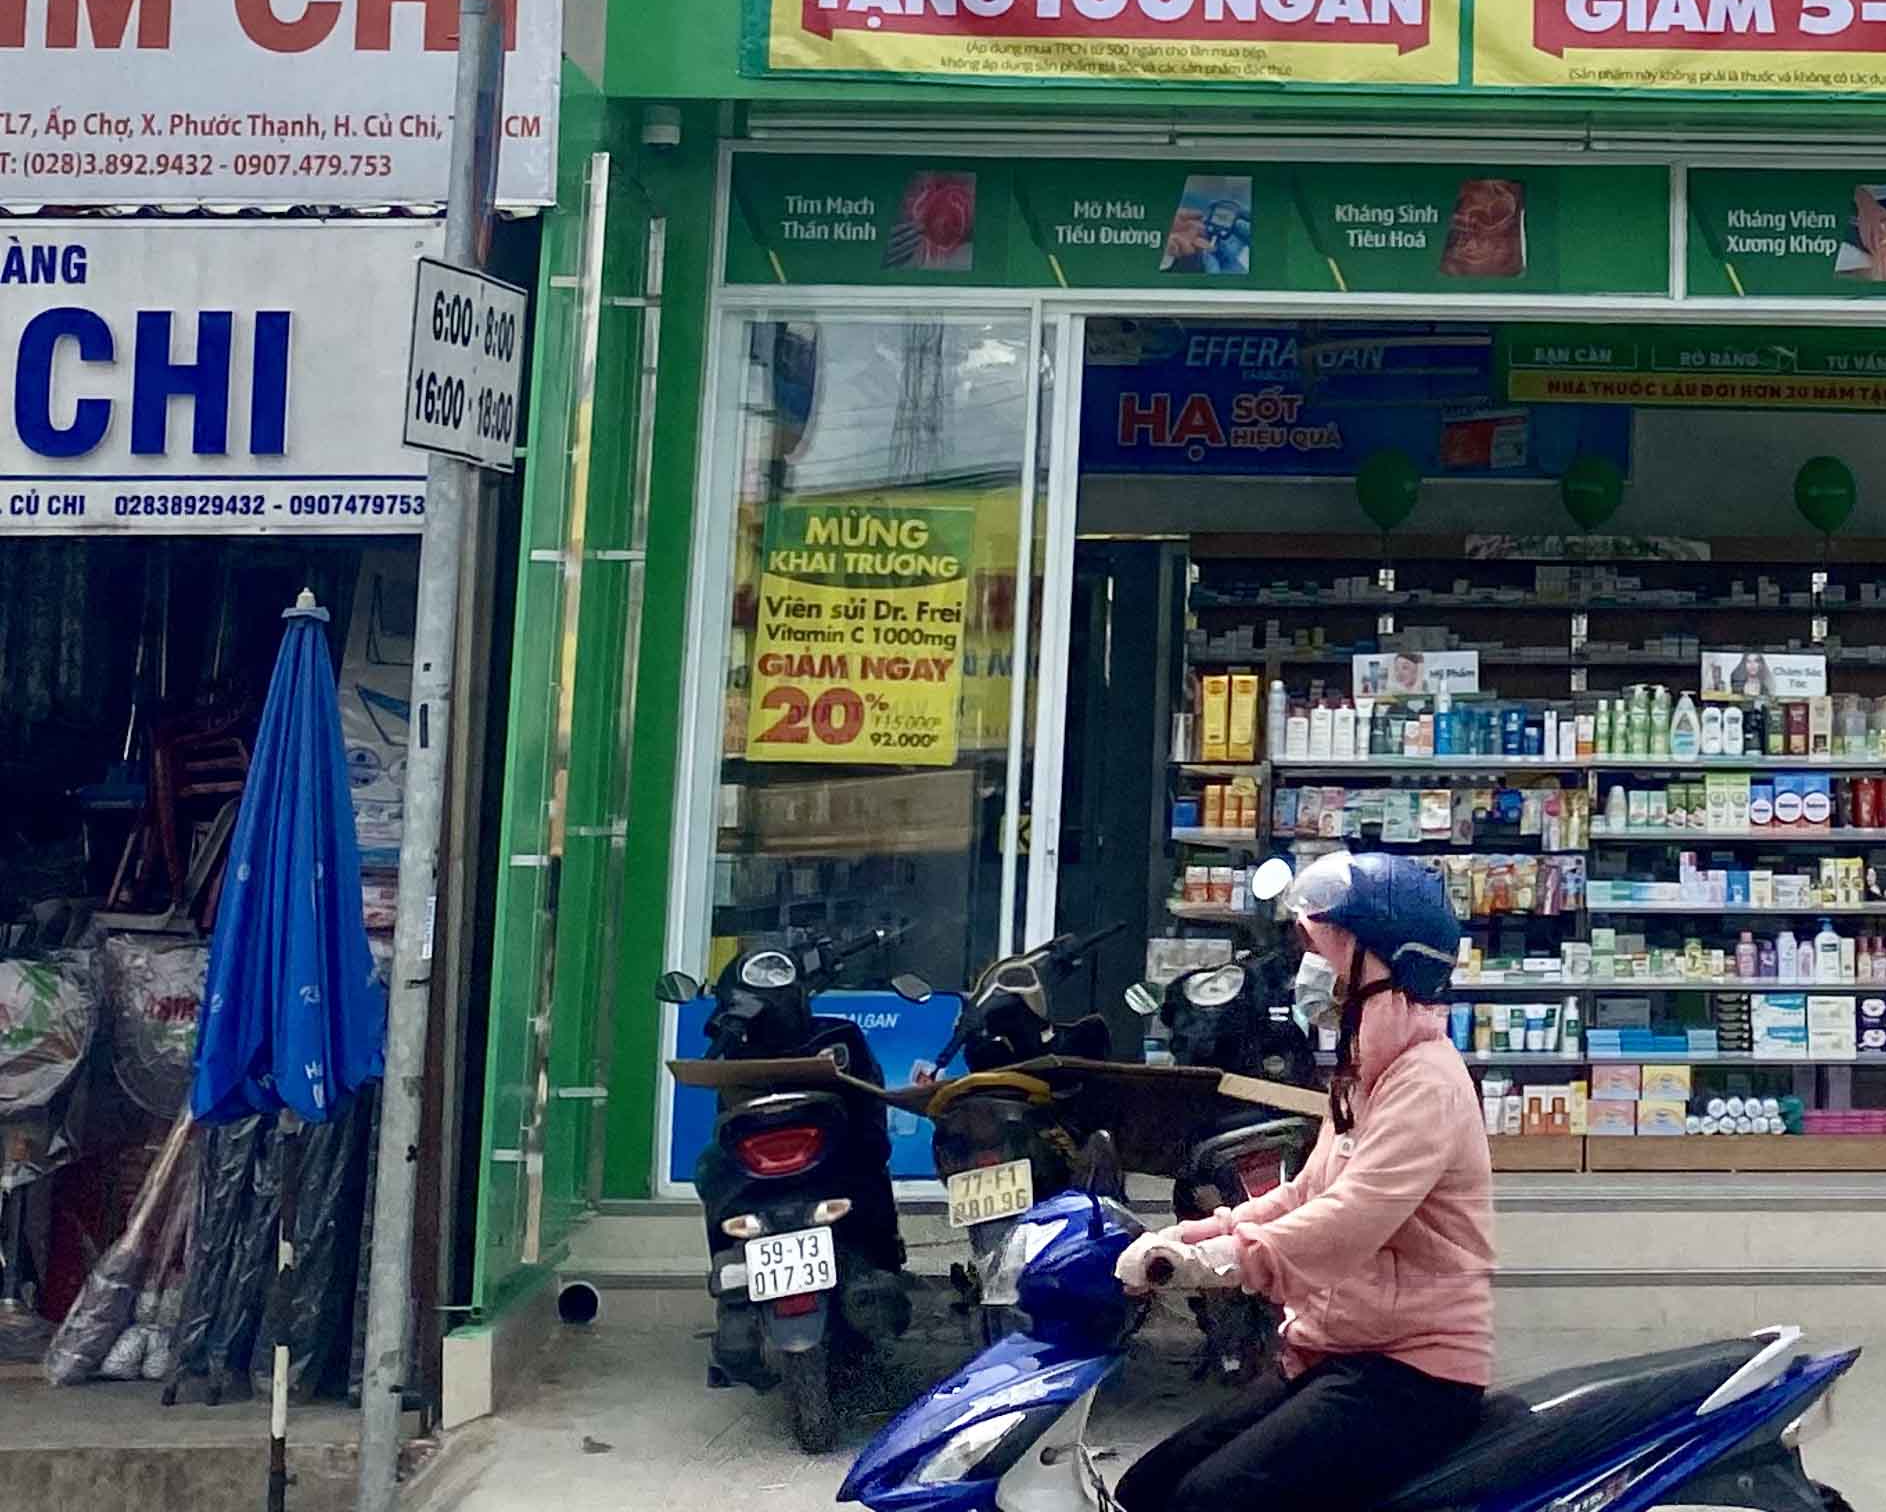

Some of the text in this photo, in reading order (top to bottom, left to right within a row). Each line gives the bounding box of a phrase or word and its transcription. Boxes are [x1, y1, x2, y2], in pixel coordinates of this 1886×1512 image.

[44, 104, 77, 144] Ấp
[141, 115, 163, 138] X.
[169, 110, 243, 139] Phước
[246, 112, 327, 145] Thạnh,
[335, 115, 359, 139] H.
[365, 108, 394, 140] Củ
[233, 154, 392, 179] 0907.479.753
[786, 195, 875, 218] Tim Mạch
[1335, 203, 1439, 226] Kháng Sinh
[1727, 207, 1837, 232] Kháng Viêm
[834, 220, 877, 241] Kinh
[1345, 228, 1386, 248] Tiêu
[1725, 234, 1786, 257] Xương
[1, 236, 88, 285] ÀNG
[433, 290, 516, 362] 6:00 8:00
[1186, 335, 1385, 369] EFFERAGAN
[14, 305, 294, 460] CHI
[415, 368, 466, 430] 16:00
[1117, 391, 1228, 463] HẠ
[10, 490, 427, 517] CỦ CHI 02838929432 0907479753
[804, 508, 929, 549] MỪNG
[768, 550, 960, 577] KHAI TRƯƠNG
[765, 594, 962, 623] Viên sủi Dr. Frei
[766, 623, 957, 651] Vitamin C 1000mg
[758, 645, 955, 682] GIẢM NGAY
[759, 1235, 819, 1267] 59-Y3
